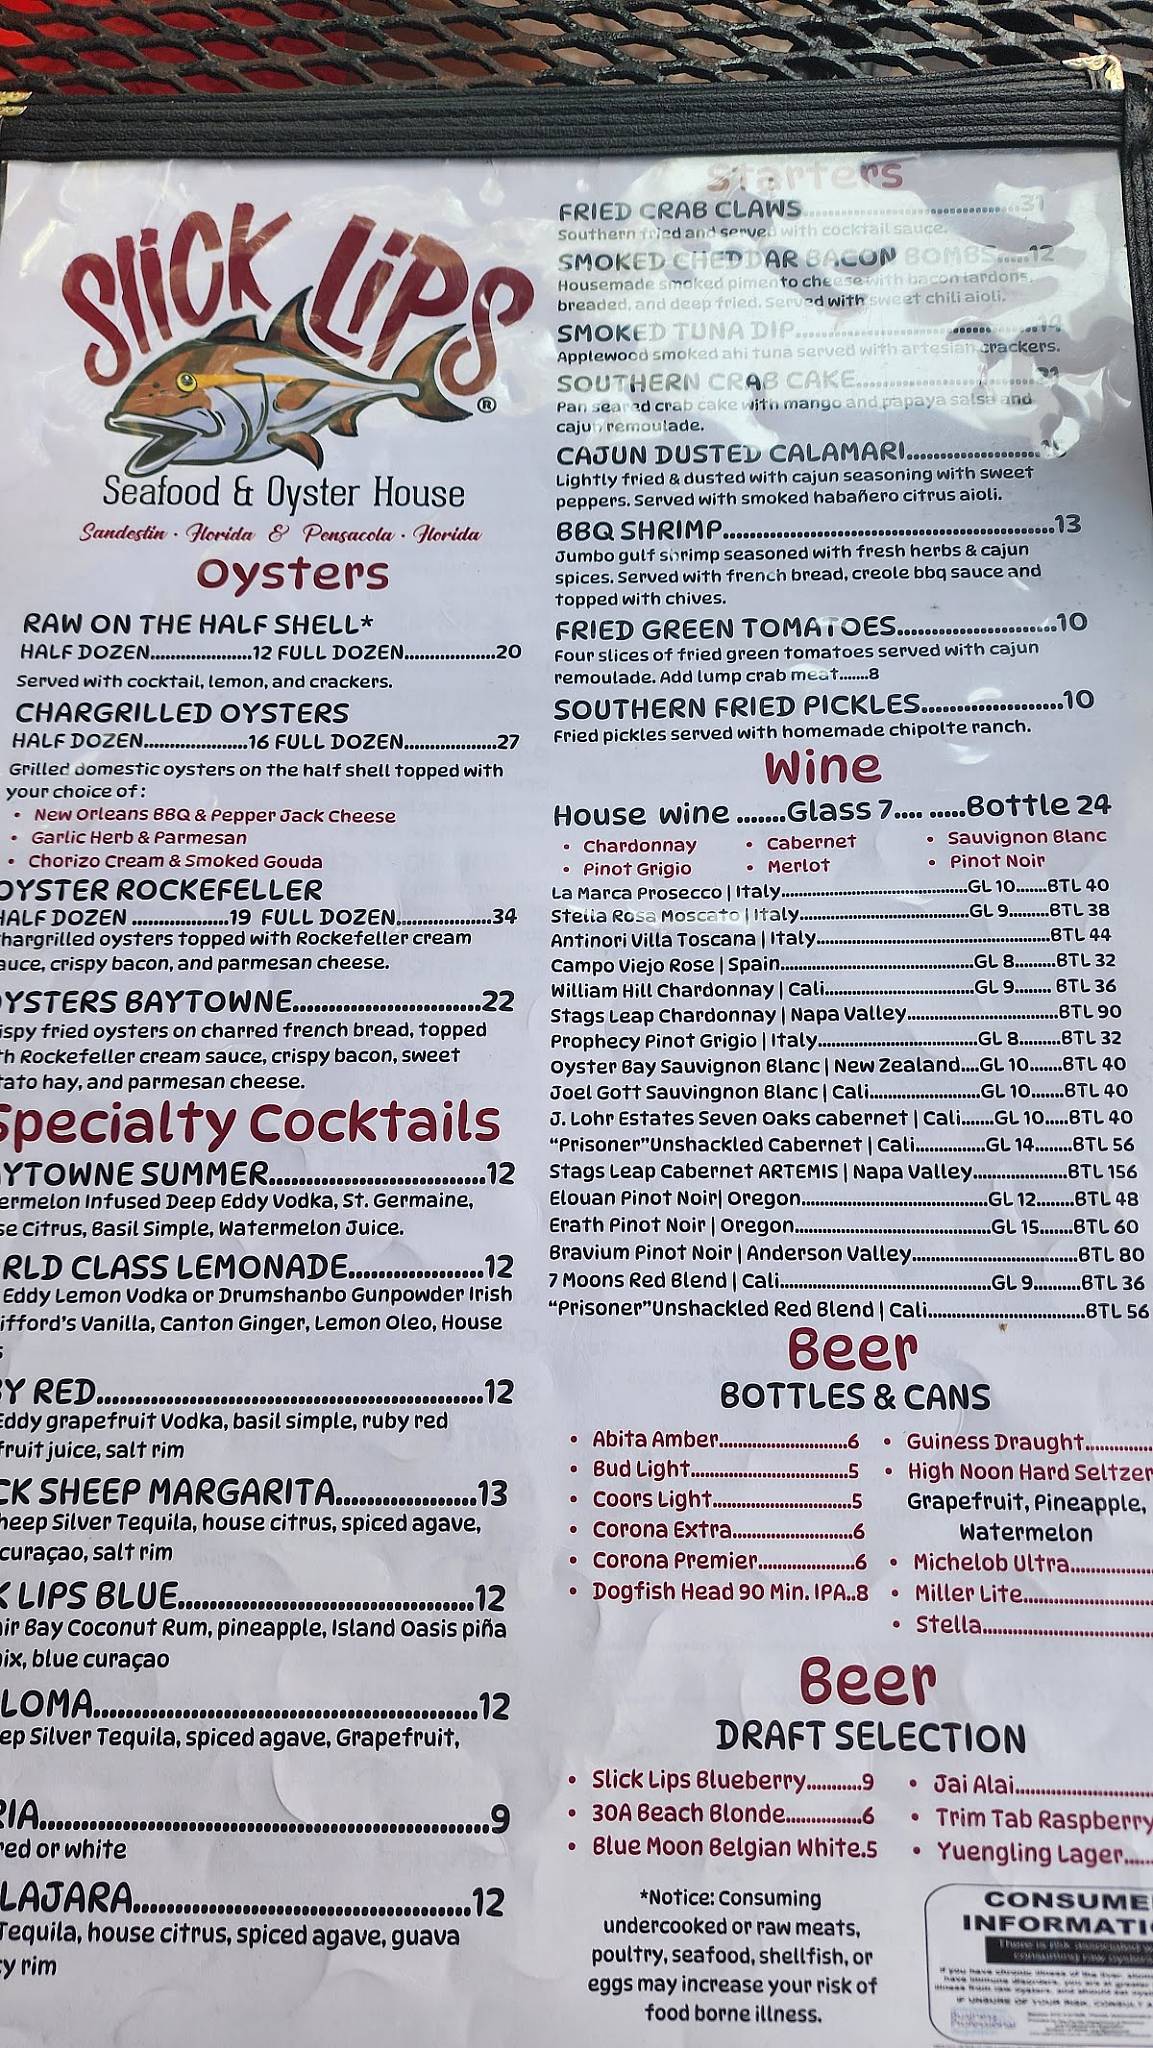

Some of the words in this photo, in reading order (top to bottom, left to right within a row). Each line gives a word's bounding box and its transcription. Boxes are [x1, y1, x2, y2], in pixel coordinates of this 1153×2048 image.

[559, 201, 632, 222] FRIED
[639, 200, 708, 221] CRAB
[556, 445, 647, 466] CAJUN
[654, 443, 762, 465] DUSTED
[102, 475, 220, 507] Seafood
[233, 474, 255, 507] &
[267, 474, 361, 517] Oyster
[373, 475, 465, 508] House
[556, 496, 631, 512] peppers.
[634, 492, 695, 507] Served
[698, 491, 737, 506] with
[741, 490, 809, 505] smoked
[813, 488, 900, 504] habañero
[902, 488, 956, 503] citrus
[959, 487, 1003, 502] aioli.
[79, 521, 166, 542] Sandestin
[185, 522, 256, 543] Florida
[268, 523, 290, 543] &
[302, 523, 396, 544] Pensacola
[412, 523, 482, 544] Florida
[556, 521, 615, 542] BBQ
[196, 555, 389, 598] Oysters
[23, 612, 83, 634] RAW
[90, 613, 131, 635] ON
[139, 613, 193, 635] THE
[199, 613, 269, 636] HALF
[555, 619, 635, 641] FRIED
[641, 618, 734, 641] GREEN
[16, 674, 80, 688] Served
[83, 674, 123, 688] with
[127, 674, 205, 690] cocktail,
[208, 674, 269, 690] lemon,
[271, 674, 306, 689] and
[309, 674, 393, 689] crackers.
[15, 701, 213, 724] CHARGRILLED
[220, 702, 350, 724] OYSTERS
[553, 697, 706, 721] SOUTHERN
[714, 695, 796, 719] FRIED
[553, 728, 599, 743] Fried
[603, 727, 667, 746] pickles
[670, 725, 733, 741] served
[737, 724, 778, 740] with
[782, 723, 886, 739] homemade
[889, 720, 969, 739] chipolte
[971, 719, 1032, 734] ranch.
[764, 748, 883, 786] Wine
[34, 808, 73, 822] New
[76, 806, 149, 822] Orleans
[153, 807, 191, 822] BBQ
[194, 808, 207, 822] &
[210, 808, 277, 826] Pepper
[279, 808, 325, 823] Jack
[328, 808, 396, 824] Cheese
[553, 804, 647, 827] House
[659, 801, 730, 825] wine
[31, 830, 87, 845] Garlic
[90, 829, 134, 845] Herb
[137, 830, 150, 845] &
[154, 830, 248, 845] Parmesan
[583, 838, 697, 855] Chardonnay
[767, 834, 857, 851] Cabernet
[947, 830, 1048, 848] Sauvignon
[1052, 828, 1107, 844] Blanc
[28, 853, 101, 869] Chorizo
[104, 854, 165, 869] Cream
[168, 854, 182, 868] &
[184, 853, 259, 869] Smoked
[263, 854, 323, 869] Gouda
[583, 861, 633, 877] Pinot
[636, 861, 692, 879] Grigio
[768, 857, 831, 874] Merlot
[950, 853, 1002, 869] Pinot
[1006, 853, 1046, 868] Noir
[116, 878, 323, 902] ROCKEFELLER
[249, 1098, 501, 1143] Cocktails
[549, 1162, 606, 1183] Stags
[609, 1163, 656, 1183] Leap
[660, 1162, 754, 1179] Cabernet
[758, 1163, 839, 1180] ARTEMIS
[853, 1163, 904, 1183] Napa
[85, 1192, 161, 1210] Infused
[165, 1193, 217, 1213] Deep
[220, 1192, 269, 1213] Eddy
[272, 1191, 339, 1211] Vodka,
[342, 1191, 369, 1209] St.
[373, 1191, 474, 1210] Germaine,
[788, 1326, 918, 1372] Beer
[720, 1381, 866, 1410] BOTTLES
[873, 1383, 897, 1411] &
[903, 1383, 991, 1411] CANS
[592, 1429, 648, 1448] Abita
[593, 1459, 631, 1478] Bud
[908, 1461, 955, 1484] High
[960, 1462, 1014, 1481] Noon
[1019, 1462, 1070, 1481] Hard
[593, 1490, 653, 1508] Coors
[907, 1491, 1030, 1515] Grapefruit,
[1034, 1492, 1147, 1517] Pineapple,
[959, 1522, 1093, 1543] Watermelon
[592, 1580, 676, 1605] Dogfish
[681, 1581, 734, 1601] Head
[738, 1583, 765, 1601] 90
[770, 1582, 810, 1601] Min.
[217, 1617, 327, 1642] pineapple,
[331, 1617, 396, 1638] Island
[400, 1618, 458, 1638] Oasis
[462, 1617, 507, 1642] piña
[32, 1648, 79, 1669] blue
[82, 1652, 170, 1673] curaçao
[800, 1655, 937, 1706] Beer
[715, 1719, 827, 1751] DRAFT
[835, 1720, 1026, 1754] SELECTION
[592, 1768, 644, 1789] Slick
[648, 1769, 691, 1793] Lips
[592, 1802, 632, 1822] 30A
[637, 1802, 704, 1823] Beach
[935, 1807, 986, 1828] Trim
[990, 1808, 1033, 1829] Tab
[593, 1834, 642, 1856] Blue
[646, 1836, 704, 1857] Moon
[709, 1836, 792, 1862] Belgian
[937, 1841, 1052, 1868] Yuengling
[718, 1889, 822, 1911] Consuming
[984, 1890, 1153, 1912] CONSUME
[603, 1916, 728, 1935] undercooked
[731, 1920, 753, 1935] or
[756, 1920, 792, 1936] raw
[795, 1919, 861, 1939] meats,
[591, 1944, 668, 1968] poultry,
[671, 1945, 756, 1967] seafood,
[759, 1946, 849, 1967] shellfish,
[852, 1951, 873, 1966] or
[587, 1977, 633, 1997] eggs
[637, 1977, 678, 1997] may
[681, 1974, 764, 1994] increase
[767, 1979, 813, 1998] your
[816, 1976, 853, 1995] risk
[855, 1976, 878, 1995] of
[644, 2002, 690, 2022] food
[694, 2003, 751, 2023] borne
[755, 2004, 822, 2024] illness.
